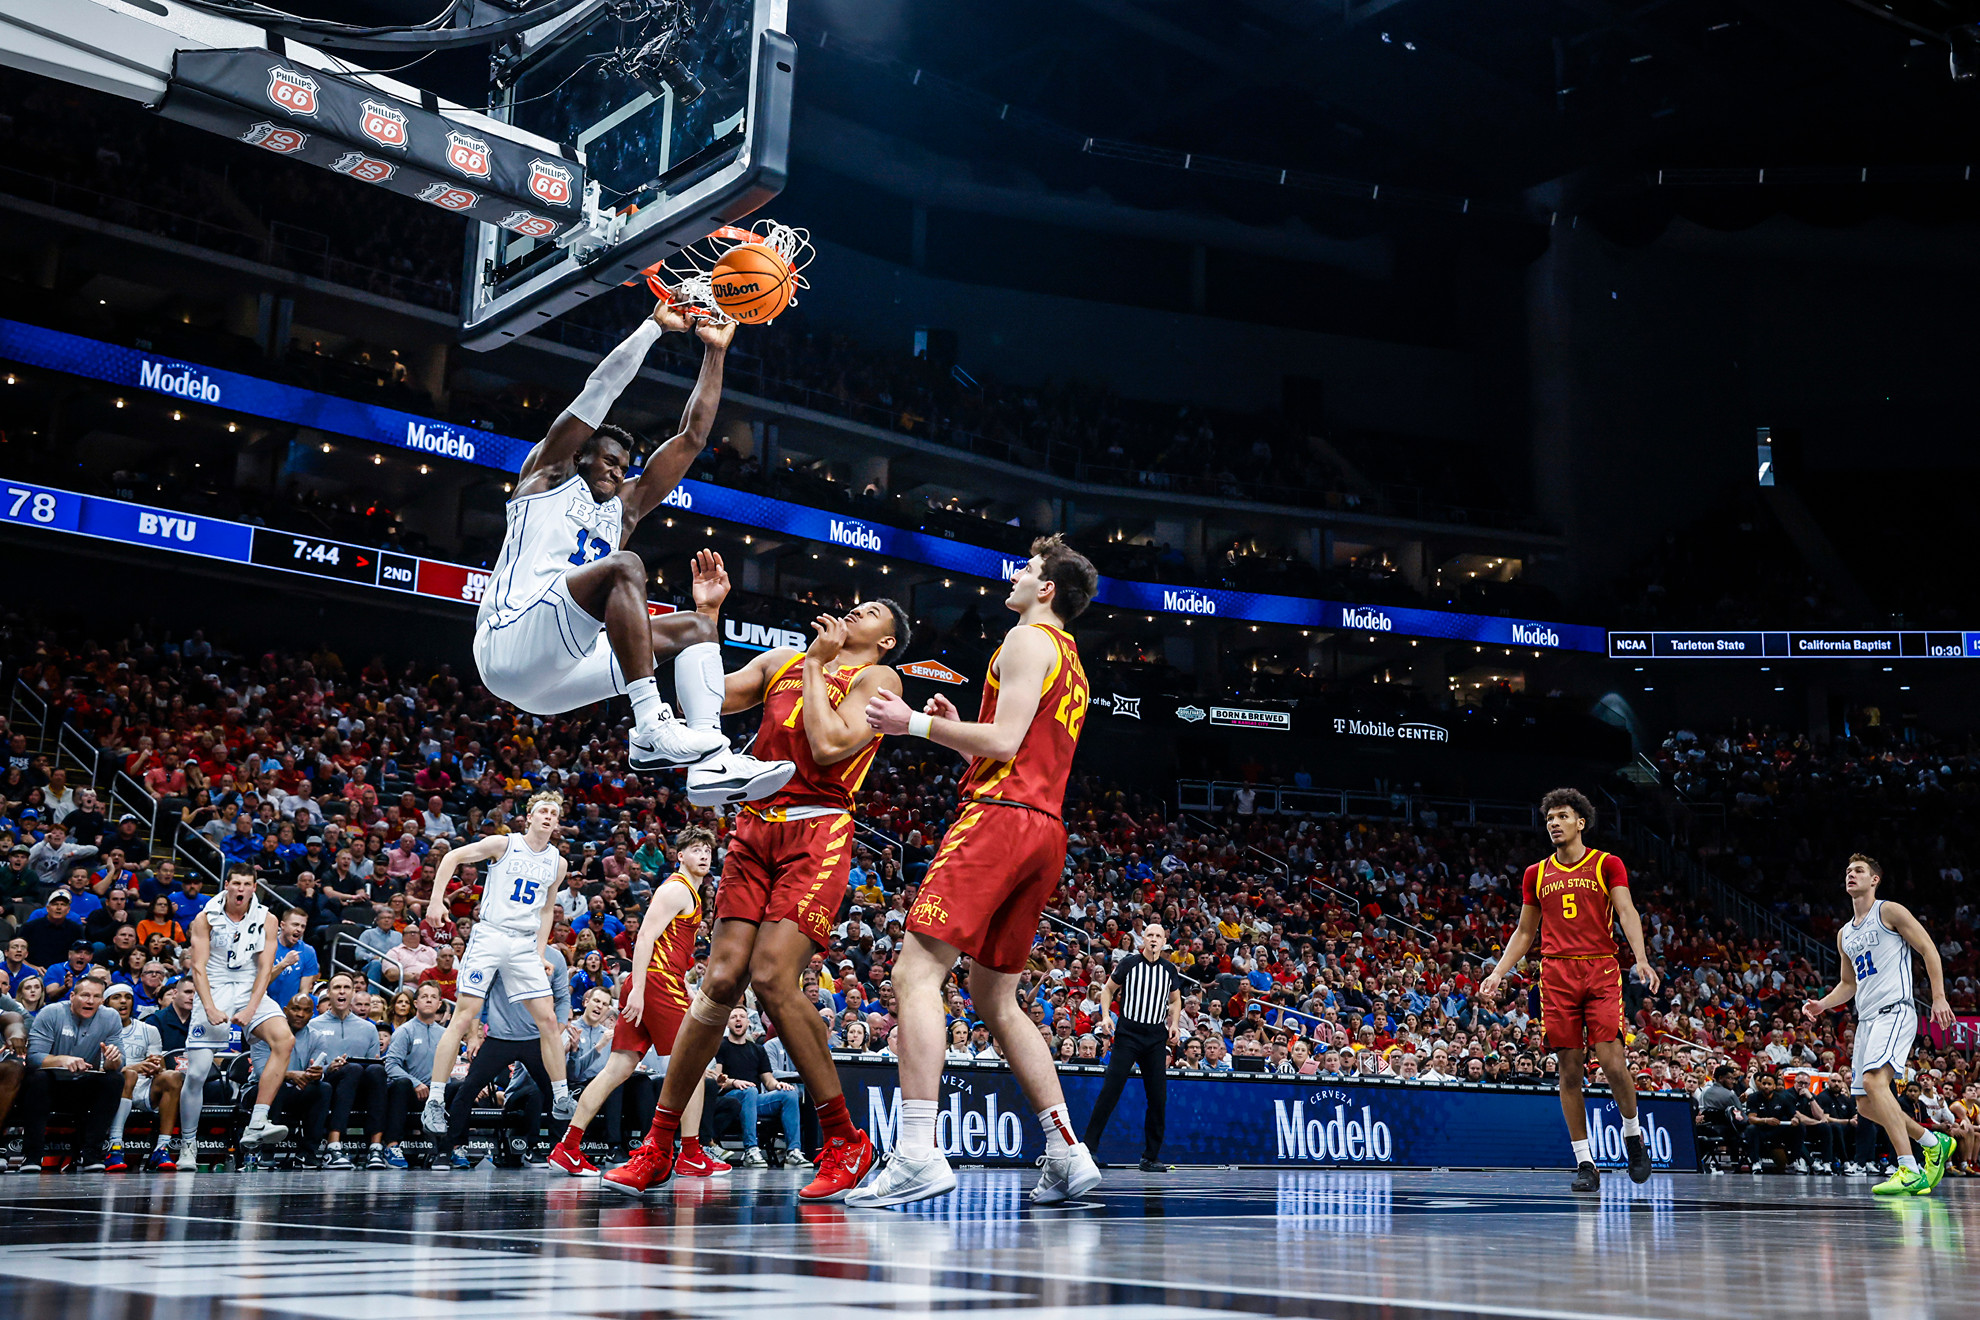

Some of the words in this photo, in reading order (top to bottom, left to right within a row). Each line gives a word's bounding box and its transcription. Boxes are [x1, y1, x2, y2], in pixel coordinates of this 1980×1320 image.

[276, 71, 312, 90] PHILLIPS
[277, 85, 308, 106] 66
[368, 104, 401, 122] PHILLIPS
[369, 118, 398, 139] 66
[266, 133, 294, 149] 66
[453, 135, 485, 153] PHILLIPS
[455, 148, 482, 169] 66
[356, 162, 383, 179] 66
[535, 164, 566, 181] PHILLIPS
[536, 178, 564, 196] 66
[441, 192, 466, 207] 66
[522, 220, 546, 234] 66
[713, 282, 759, 298] Wilson
[140, 360, 220, 402] Modelo
[406, 421, 475, 460] Modelo
[8, 487, 56, 523] 78
[661, 486, 692, 508] elo
[138, 512, 197, 542] BYU
[830, 519, 881, 551] Modelo
[292, 540, 340, 565] 7:44
[383, 567, 412, 582] 2ND
[467, 572, 492, 588] IO
[1164, 591, 1215, 614] Modelo
[1343, 608, 1391, 631] Modelo
[725, 619, 807, 652] UMB
[1512, 624, 1559, 646] Modelo
[1617, 640, 1646, 650] NCAA
[1671, 640, 1714, 650] Tarleton
[1717, 640, 1745, 650] State
[1799, 639, 1851, 650] California
[1853, 639, 1891, 651] Baptist
[1931, 645, 1961, 656] 10:30
[911, 665, 953, 680] SERVPRO
[783, 696, 803, 728] 1
[1055, 670, 1086, 742] 22
[1093, 697, 1100, 705] of
[1101, 697, 1111, 707] the
[1216, 711, 1239, 719] BORN
[1248, 713, 1284, 722] BREWED
[1348, 720, 1395, 738] Mobile
[1398, 727, 1444, 741] CENTER
[510, 878, 540, 905] 15
[1542, 880, 1564, 898] IOWA
[1568, 878, 1598, 892] STATE
[912, 902, 949, 925] STATE
[1562, 893, 1577, 919] 5
[808, 911, 832, 937] STATE
[1855, 950, 1878, 982] 21
[942, 1075, 973, 1095] VEZA
[1310, 1090, 1352, 1107] CERVEZA
[867, 1086, 1022, 1158] Mdelo
[1274, 1099, 1392, 1162] Modelo
[400, 1140, 433, 1149] Allstate
[587, 1142, 609, 1150] Allsta
